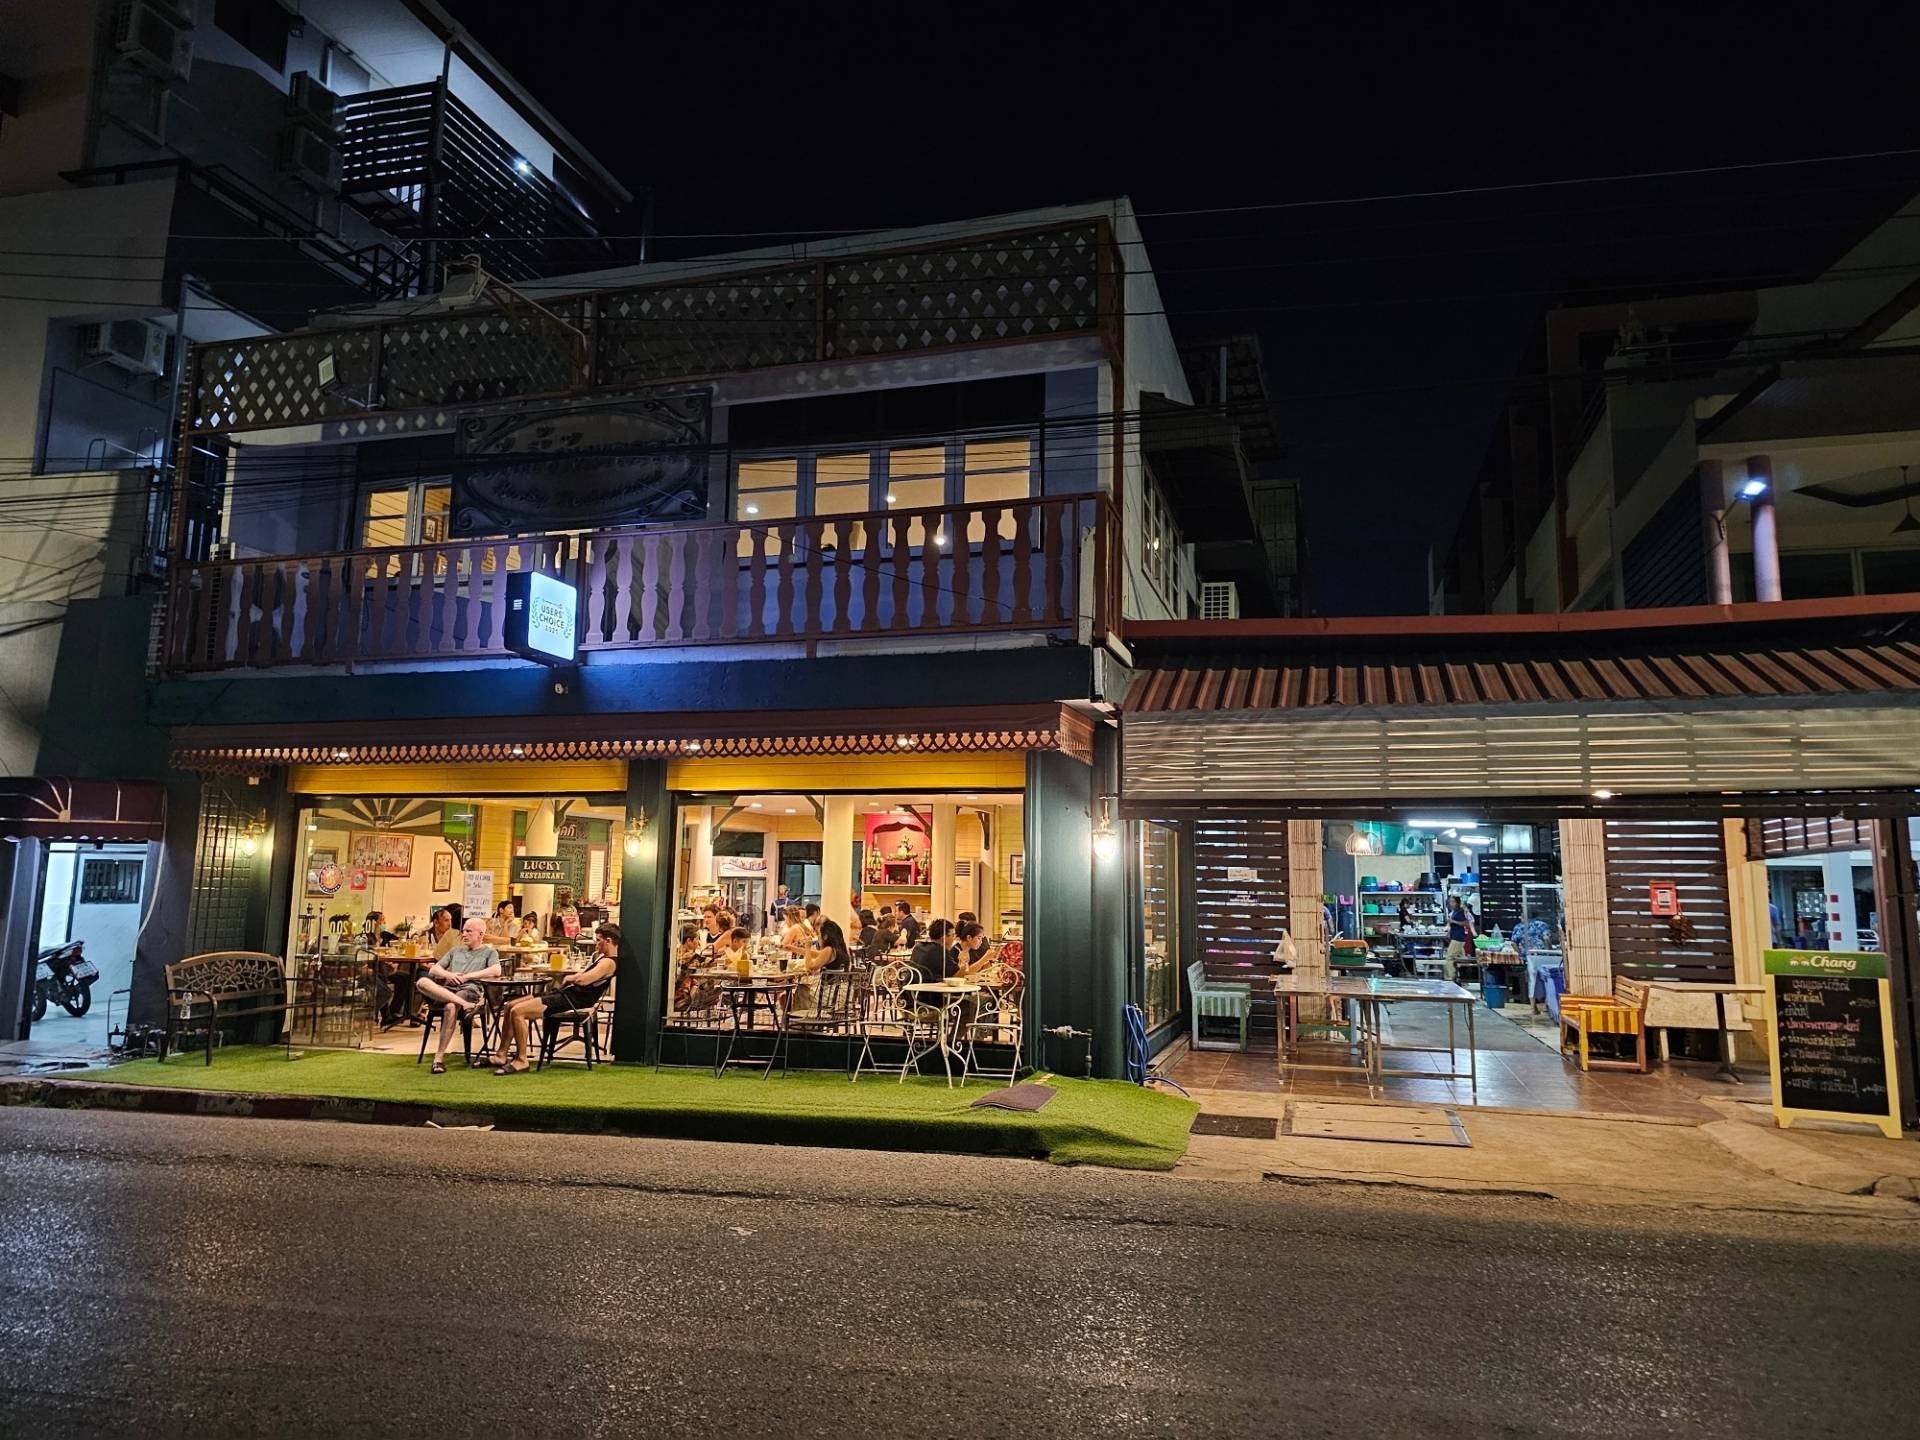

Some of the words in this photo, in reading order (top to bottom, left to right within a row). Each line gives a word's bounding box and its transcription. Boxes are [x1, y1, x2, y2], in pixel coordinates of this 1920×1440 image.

[539, 613, 565, 629] CHOICE
[523, 860, 561, 871] LUCKY
[520, 871, 565, 880] RESTAURANT
[1810, 955, 1857, 971] Chang
